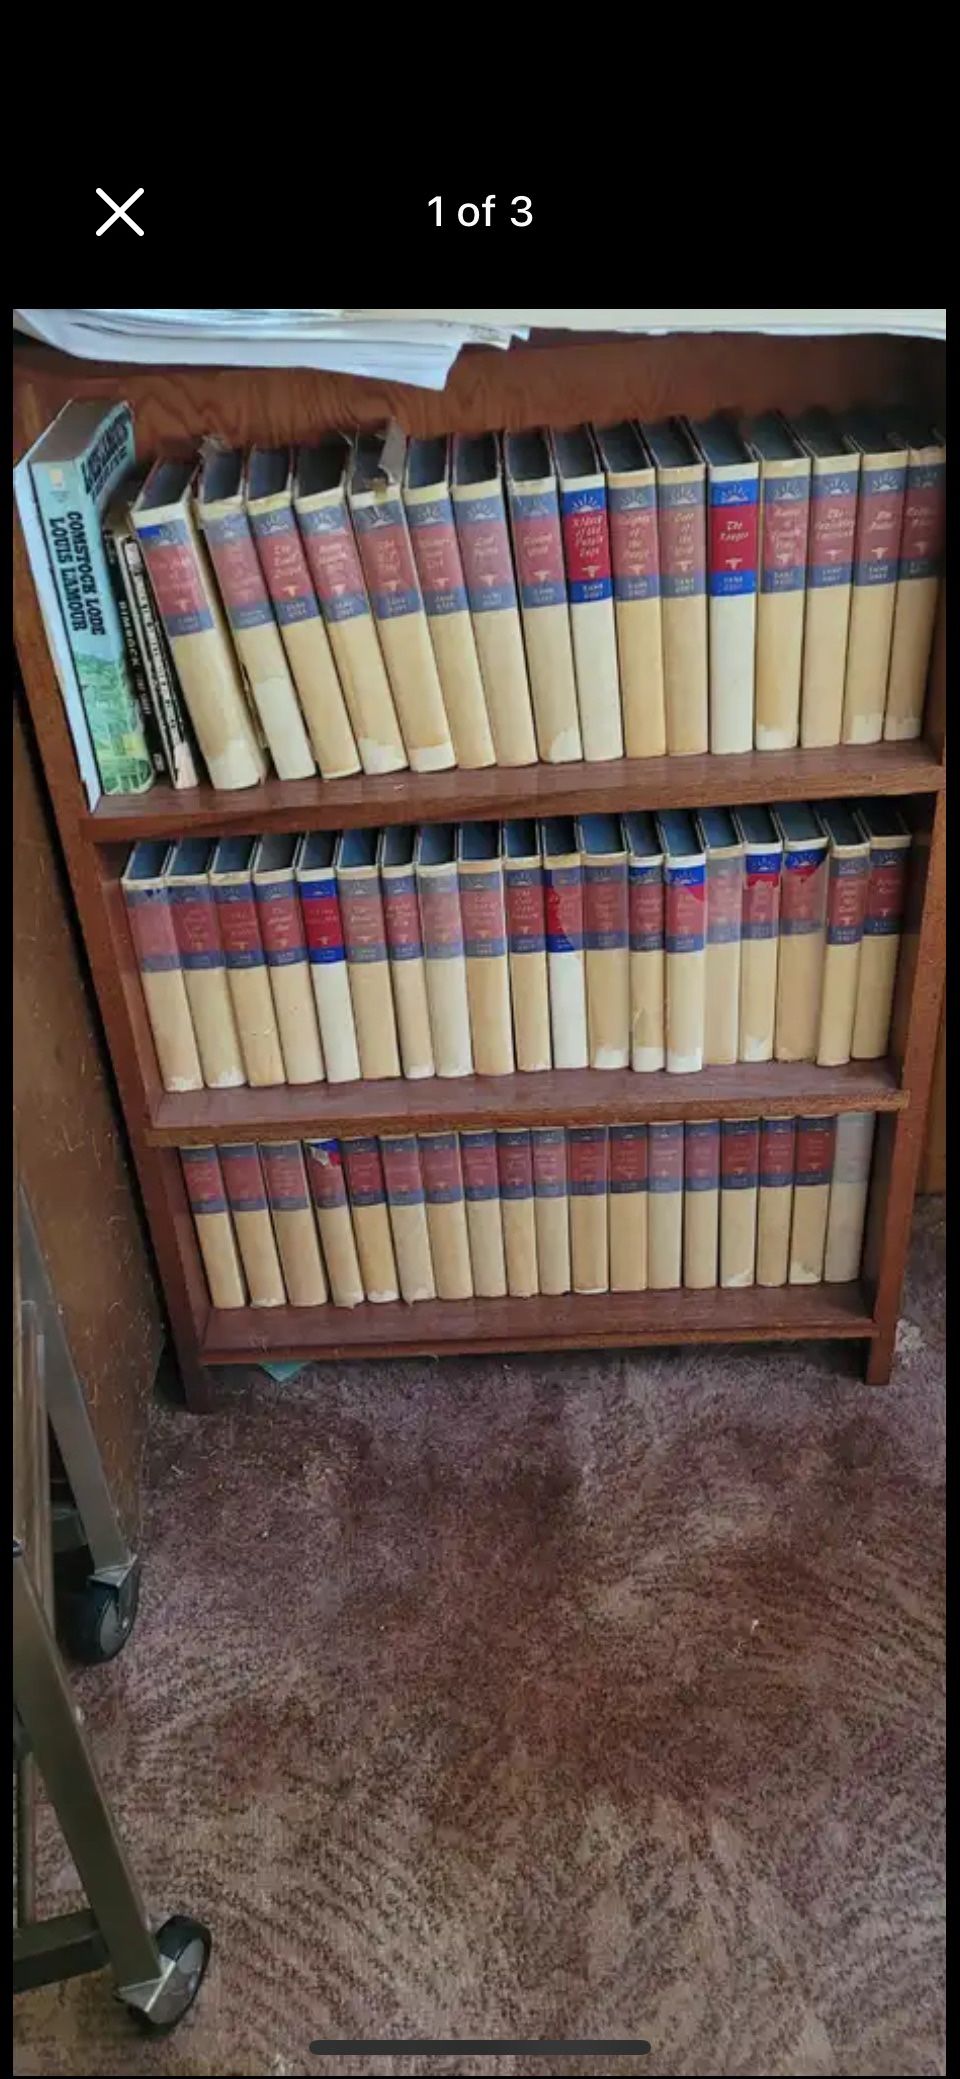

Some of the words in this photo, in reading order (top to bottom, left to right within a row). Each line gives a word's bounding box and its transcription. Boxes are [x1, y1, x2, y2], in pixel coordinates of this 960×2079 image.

[49, 516, 73, 565] LOUIS
[720, 531, 749, 542] Ranger
[727, 521, 743, 530] The
[67, 511, 97, 592] COMSTOCK
[86, 592, 106, 636] LODE
